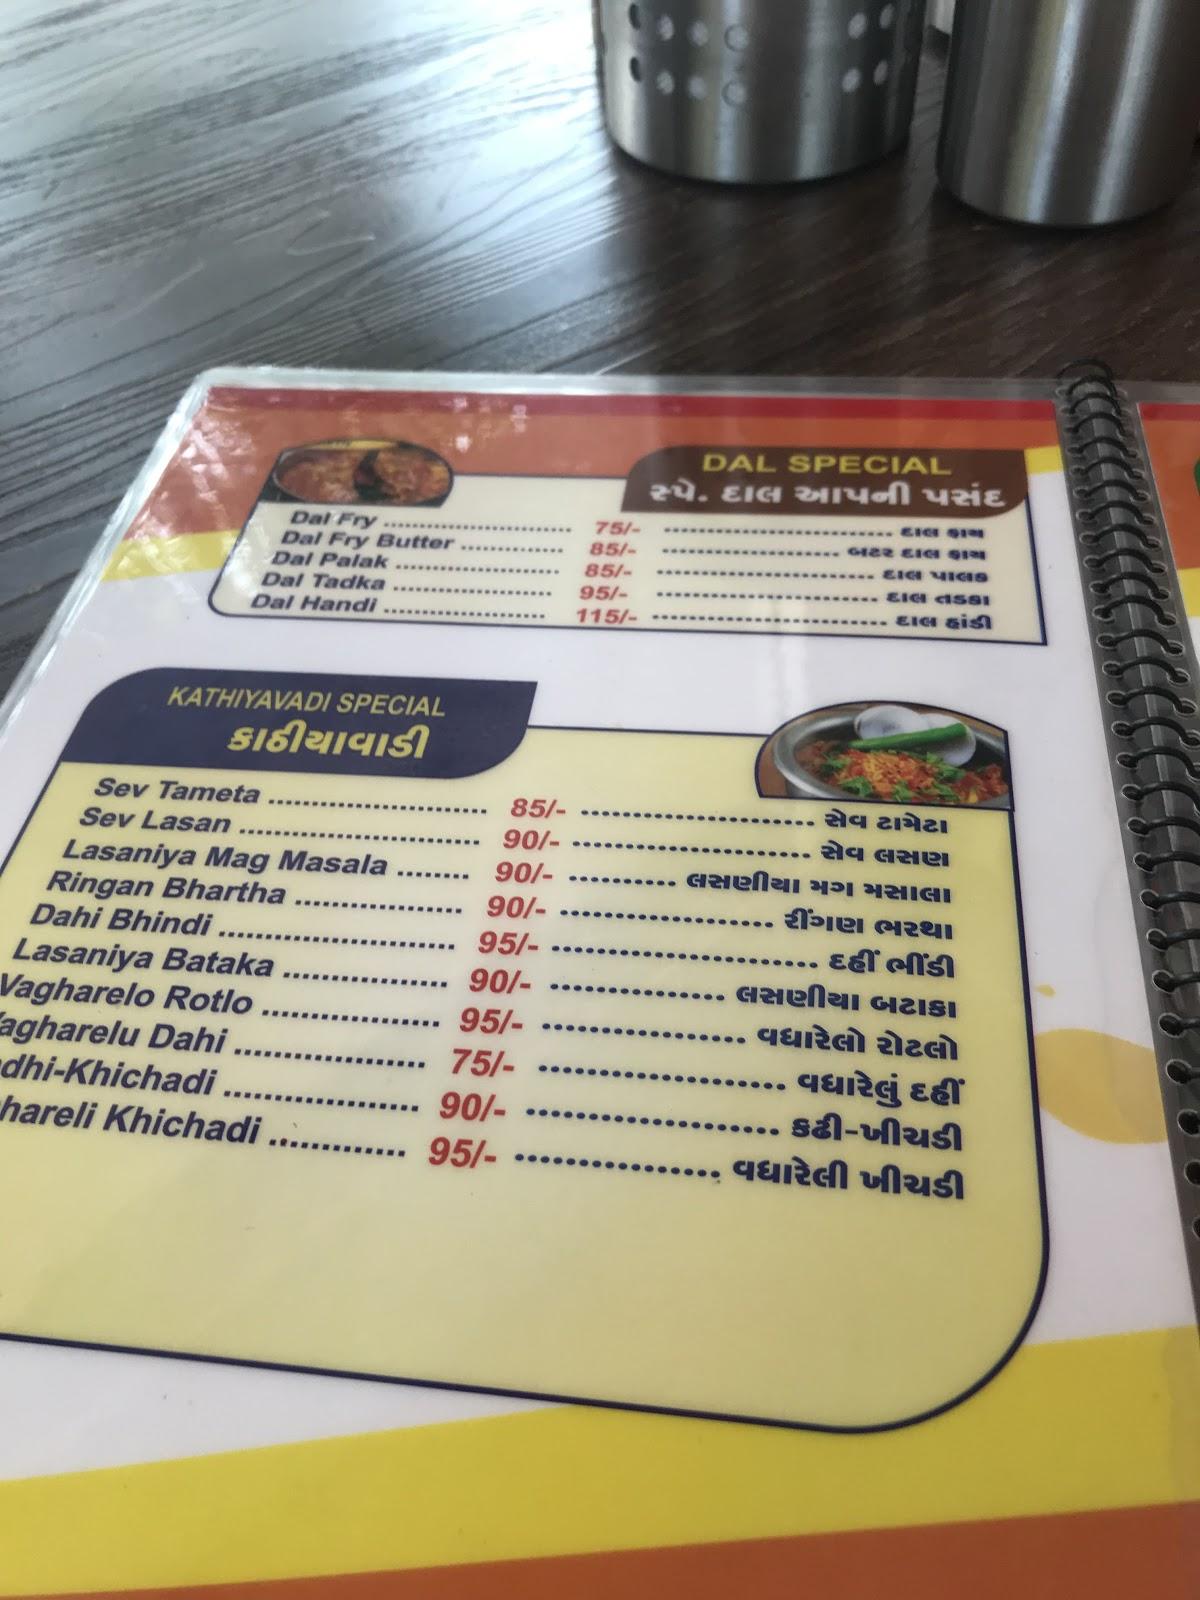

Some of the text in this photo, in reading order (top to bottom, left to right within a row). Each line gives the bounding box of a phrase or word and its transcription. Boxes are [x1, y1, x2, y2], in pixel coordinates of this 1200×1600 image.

[703, 454, 951, 475] DAL SPECIAL
[721, 485, 781, 503] દાલ
[795, 481, 910, 505] આપની
[922, 483, 1005, 507] પસંદ
[290, 510, 640, 535] Dal Fry 75/-
[901, 527, 939, 540] દાલ
[281, 531, 636, 556] Dal Fry Butter 85/-
[901, 548, 940, 559] દાલ
[272, 551, 632, 578] Dal Palak 85/-
[883, 569, 988, 583] દાલ પાલક
[261, 572, 627, 601] Dal Tadka 95/-
[886, 592, 927, 604] દાલ
[251, 594, 637, 624] Dal Handi 115/-
[896, 616, 937, 627] દાલ
[167, 686, 445, 716] KATHIYAVADI SPECIAL
[227, 719, 430, 758] કાઠીયાવાડી
[94, 777, 566, 819] Sev Tameta 85/-
[79, 807, 560, 851] Sev Lasan 90/-
[825, 808, 948, 834] સેવ ટામેટા
[62, 839, 553, 884] Lasaniya Mag Masala 90/-
[821, 840, 949, 867] સેવ લસણ
[46, 870, 546, 919] Ringan Bhartha 90/-
[686, 870, 951, 903] લસણીયા મગ મસાલા
[30, 903, 539, 956] Dahi Bhindi 95/-
[874, 920, 953, 940] ભરથા
[12, 938, 531, 994] Lasaniya Bataka 90/-
[0, 973, 523, 1035] Vagharelo Rotlo 95/-
[736, 984, 956, 1018] લસણીયા બટાકા
[0, 1011, 514, 1077] agharelu Dahi 75/-
[876, 1030, 958, 1061] રોટલો
[439, 1091, 506, 1122] 90/-
[103, 1104, 262, 1144] Khichadi
[428, 1137, 496, 1169] 95/-
[859, 1164, 964, 1200] ખીચડી
